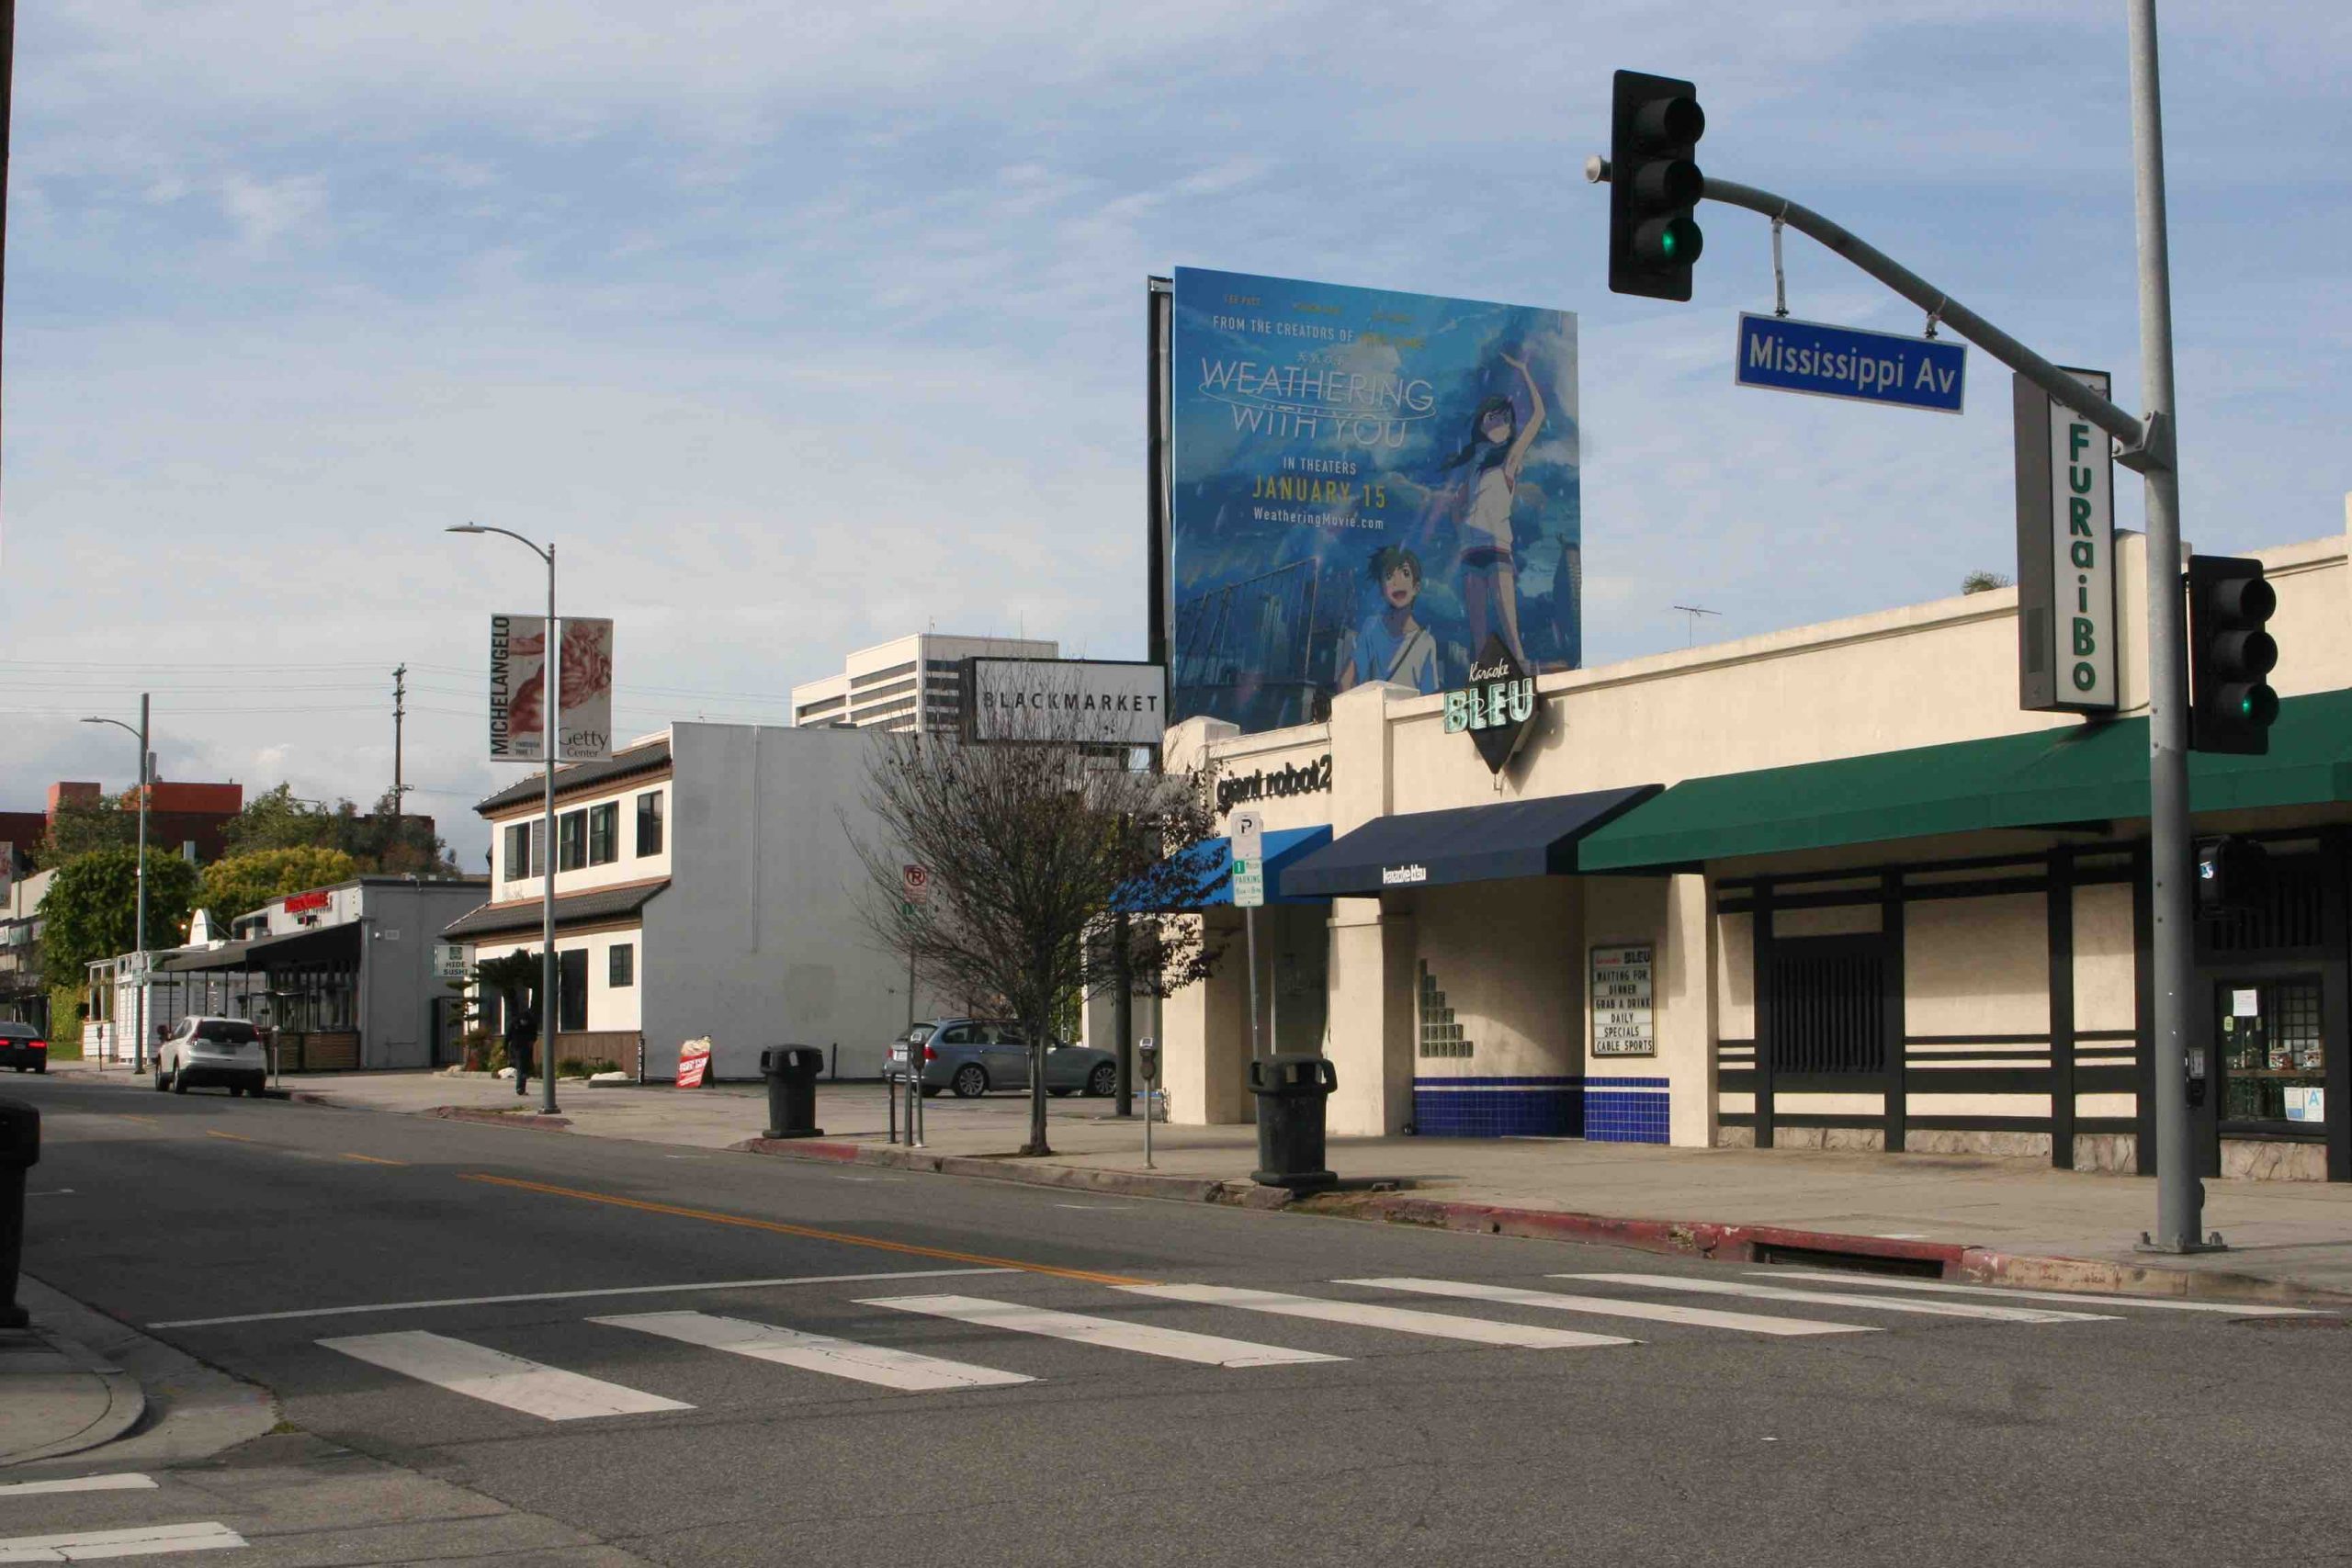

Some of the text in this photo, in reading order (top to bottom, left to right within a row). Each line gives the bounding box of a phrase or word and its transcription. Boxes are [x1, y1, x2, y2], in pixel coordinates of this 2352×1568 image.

[1213, 315, 1245, 332] FROM
[1251, 319, 1272, 333] THE
[1276, 322, 1334, 341] CREATORS
[1340, 329, 1352, 342] OF
[1749, 333, 1956, 394] Mississippi Av
[1200, 357, 1434, 412] WEATHERING
[1231, 403, 1408, 447] WITH YOU
[1283, 457, 1357, 475] IN THEATERS
[1252, 474, 1386, 508] JANUARY 15
[1253, 506, 1384, 530] WeatheringMovie.com
[1468, 658, 1510, 682] Karaoke
[492, 616, 510, 755] MICHELANGELO
[983, 692, 1158, 713] BLACKMARKET
[1444, 677, 1532, 734] BLEU
[567, 748, 599, 758] Center
[1597, 969, 1647, 982] WAITING FOR
[1609, 984, 1636, 995] DINNER
[1595, 998, 1651, 1010] GRAB A DRINK
[1611, 1011, 1634, 1024] DAILY
[1604, 1025, 1640, 1038] SPECIALS
[1596, 1040, 1653, 1052] CABLE SPORTS
[2308, 1089, 2320, 1106] A
